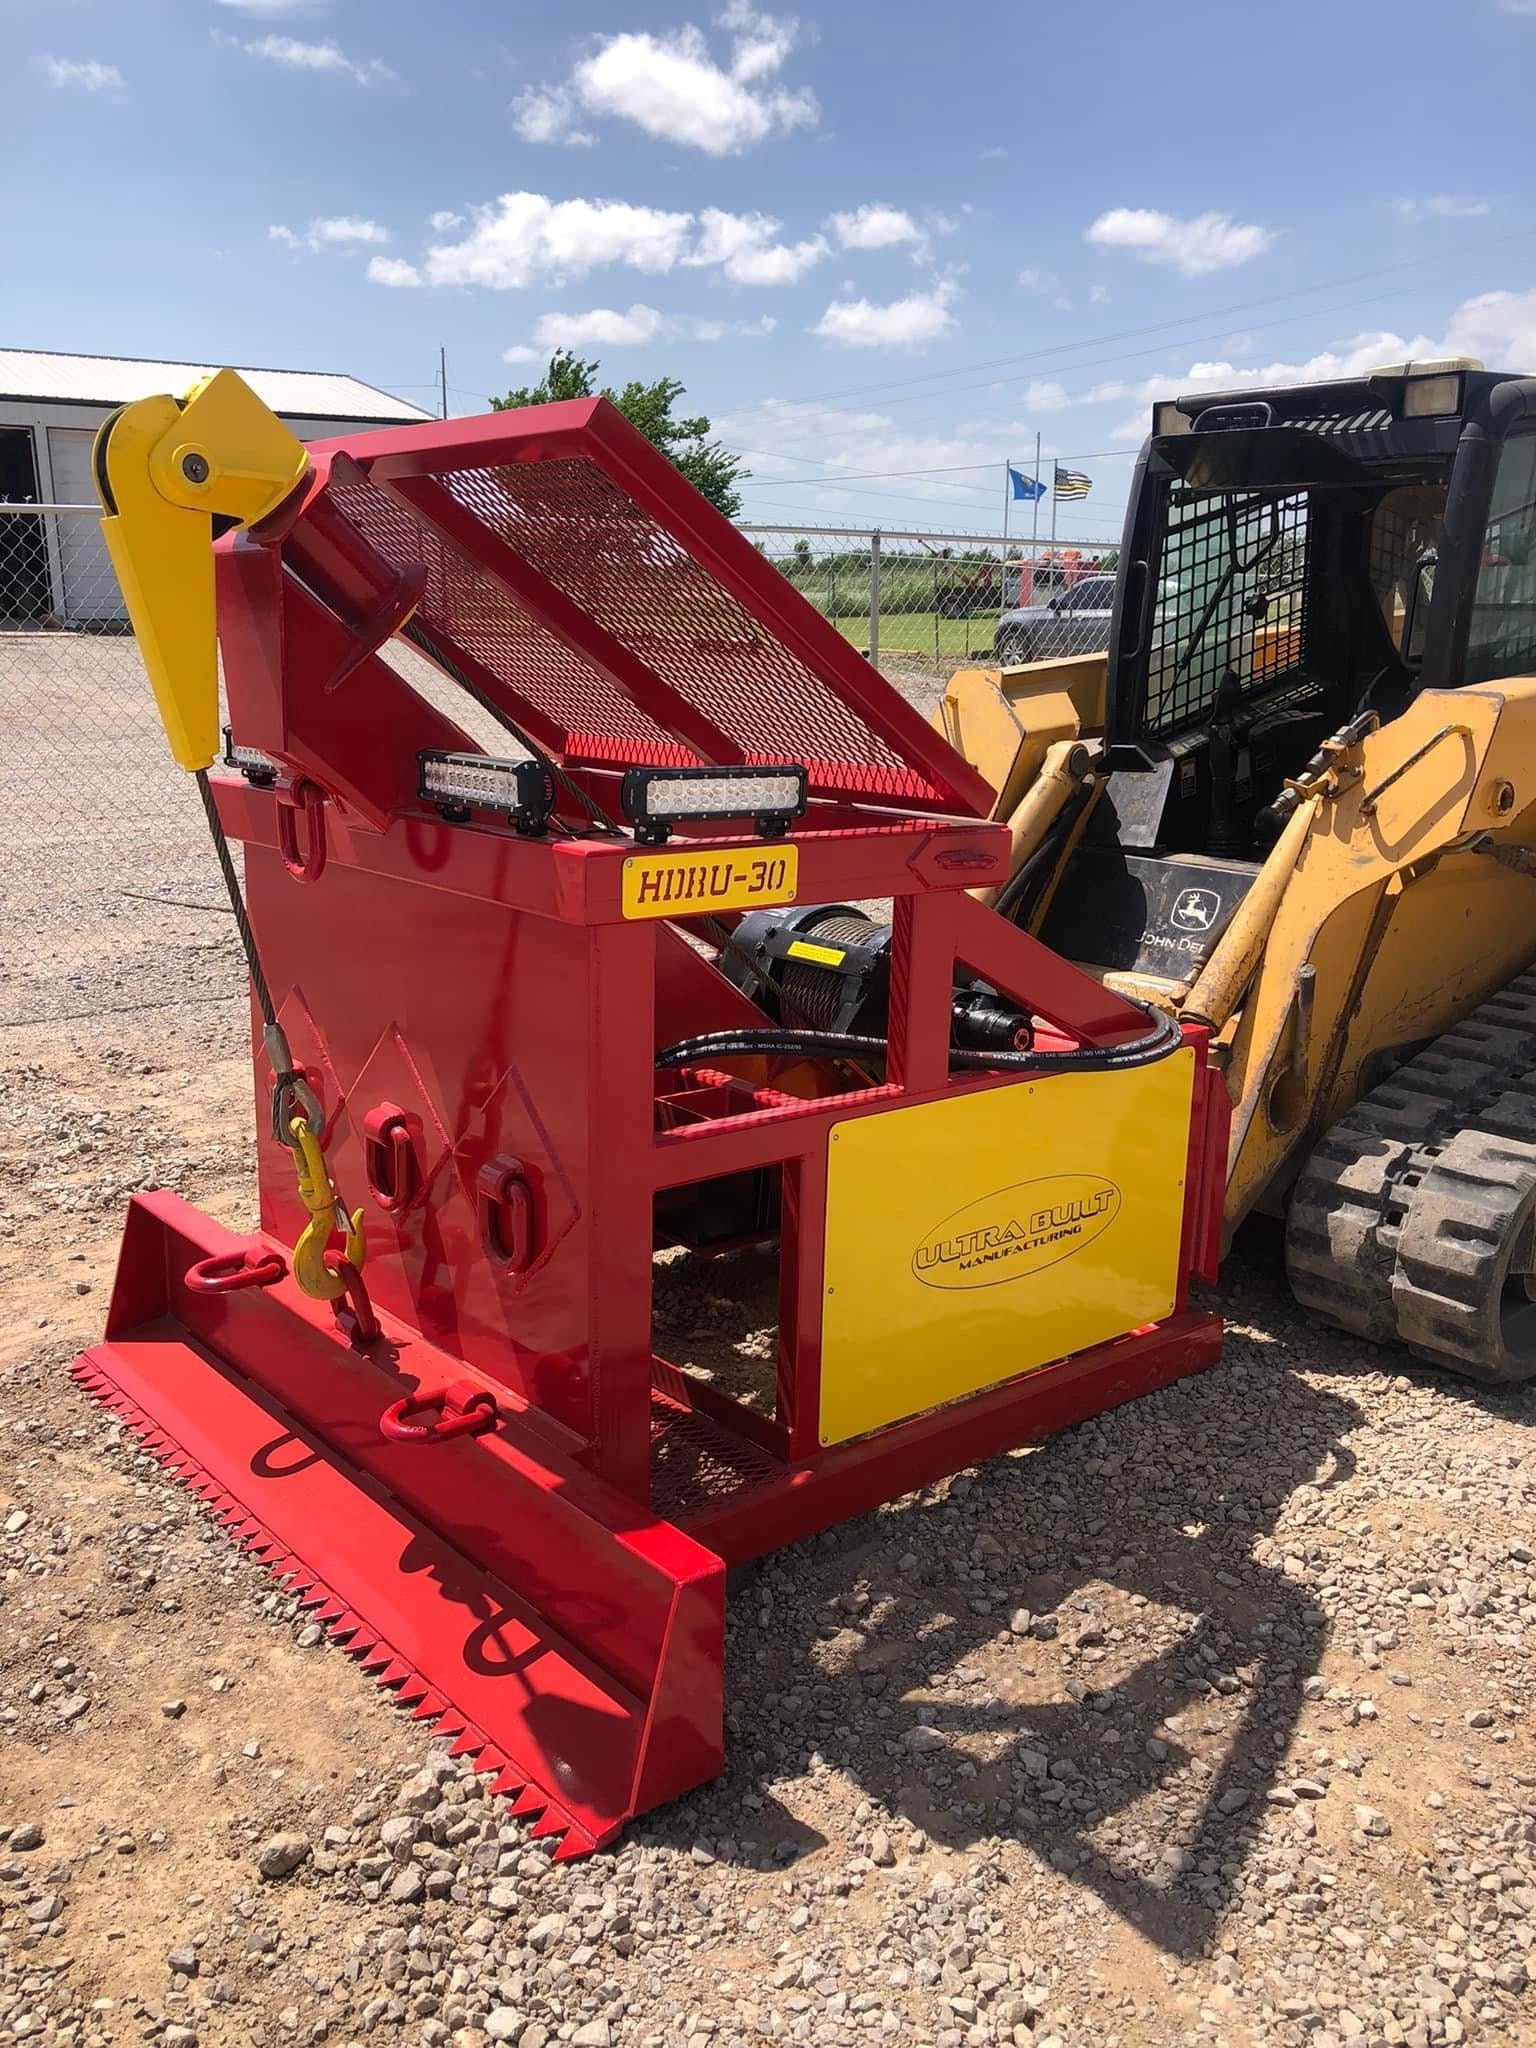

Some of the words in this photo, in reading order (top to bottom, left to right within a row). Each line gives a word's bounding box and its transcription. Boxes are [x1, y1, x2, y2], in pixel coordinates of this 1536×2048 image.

[637, 859, 786, 904] HDRU-30
[1135, 931, 1177, 949] JOHN
[915, 1219, 1026, 1270] ULTRA
[1029, 1189, 1114, 1234] BUILT
[958, 1224, 1082, 1272] MANUFACTURING
